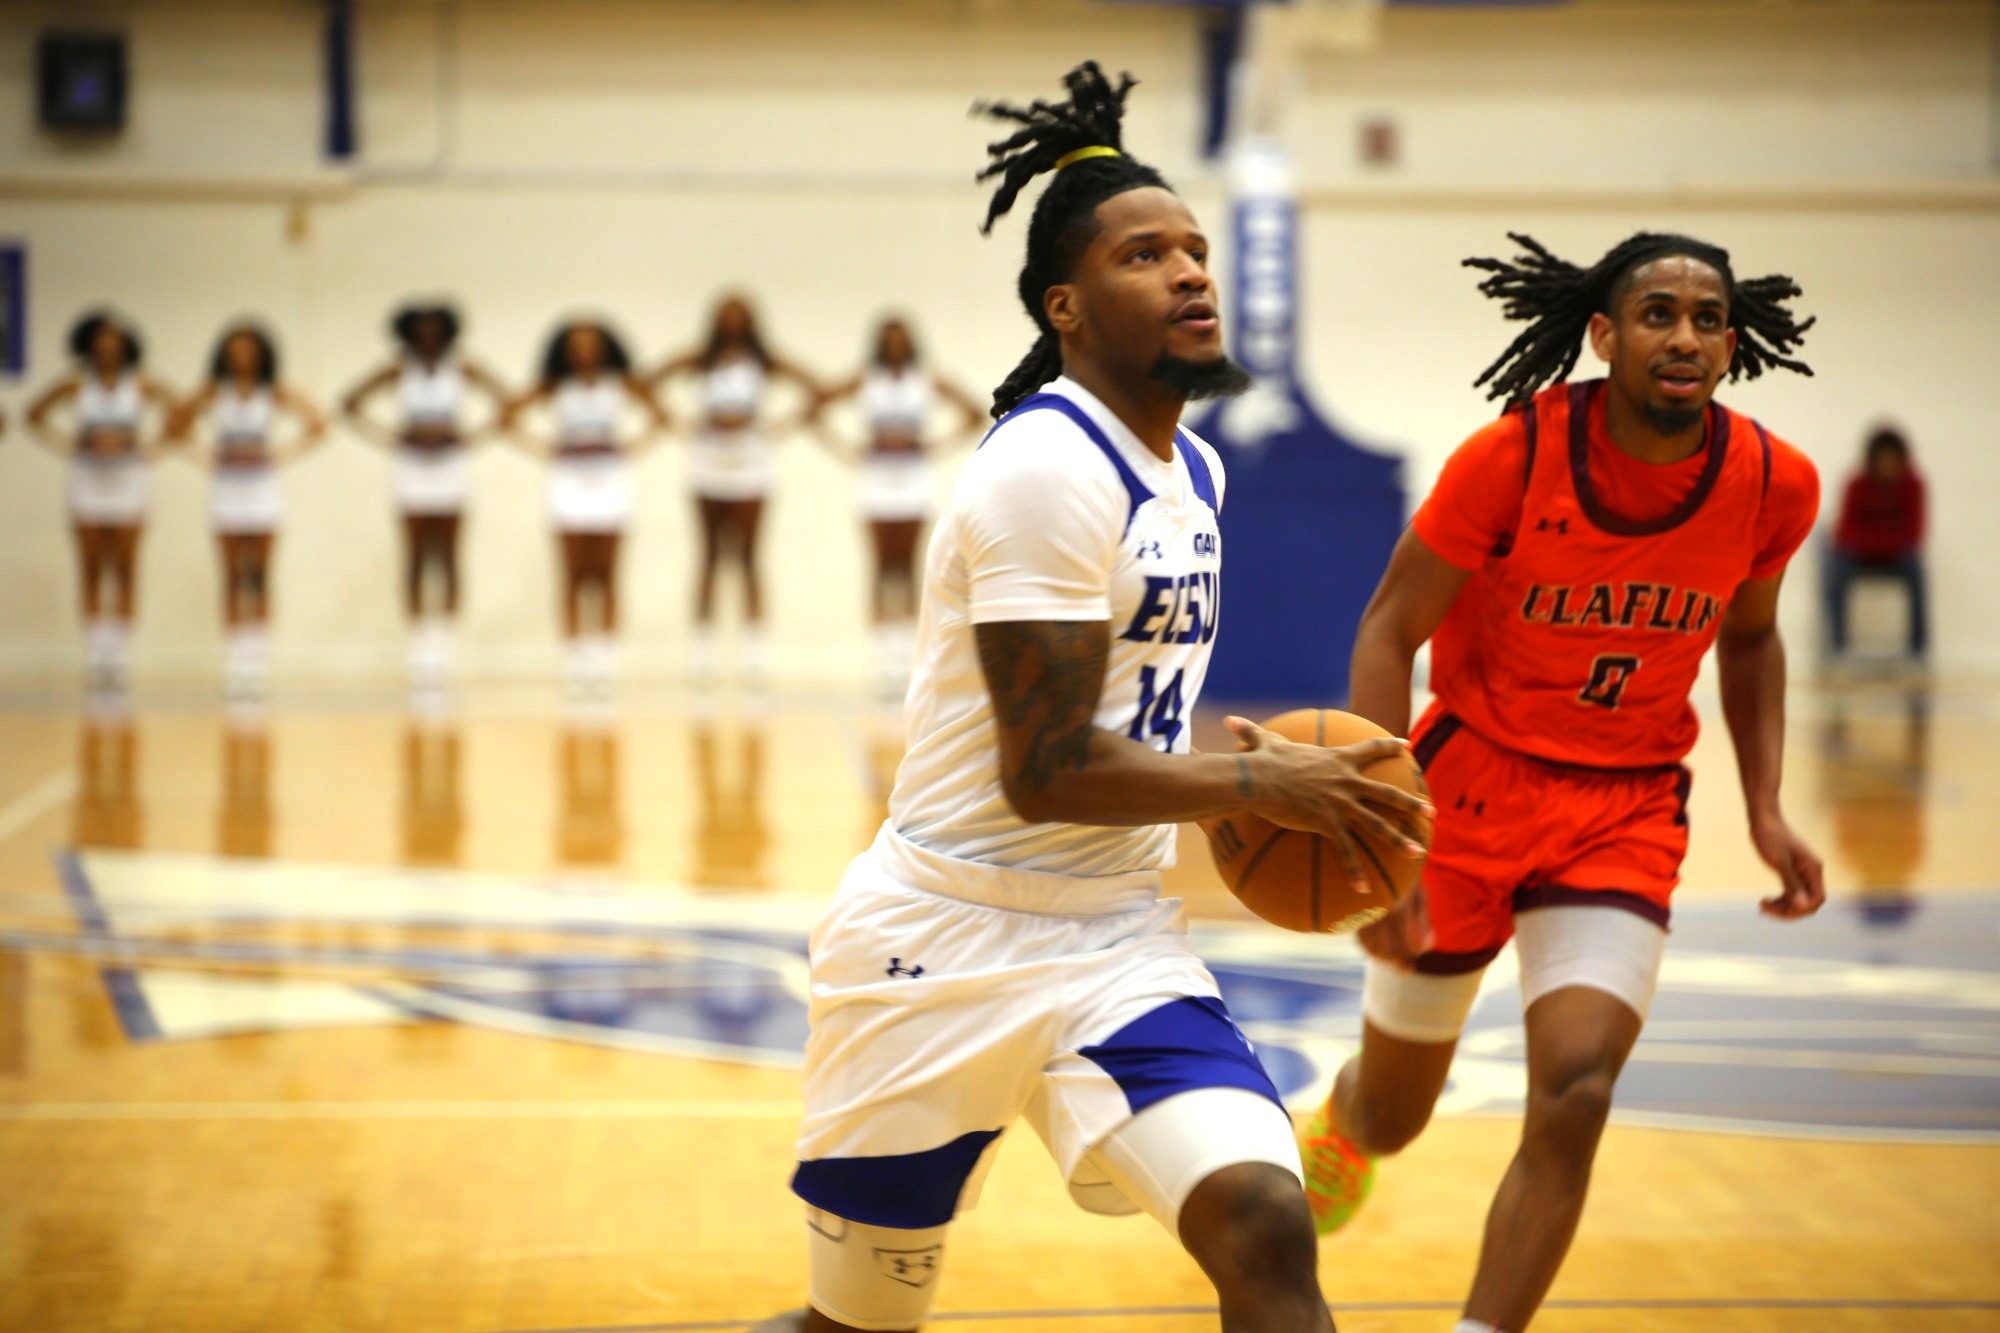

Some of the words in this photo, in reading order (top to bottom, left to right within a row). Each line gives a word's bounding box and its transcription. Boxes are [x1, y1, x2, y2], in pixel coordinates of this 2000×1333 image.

[1117, 571, 1217, 645] ECSU
[1522, 582, 1722, 633] CLAFLIN
[1129, 663, 1184, 754] 14
[1577, 653, 1642, 712] 0
